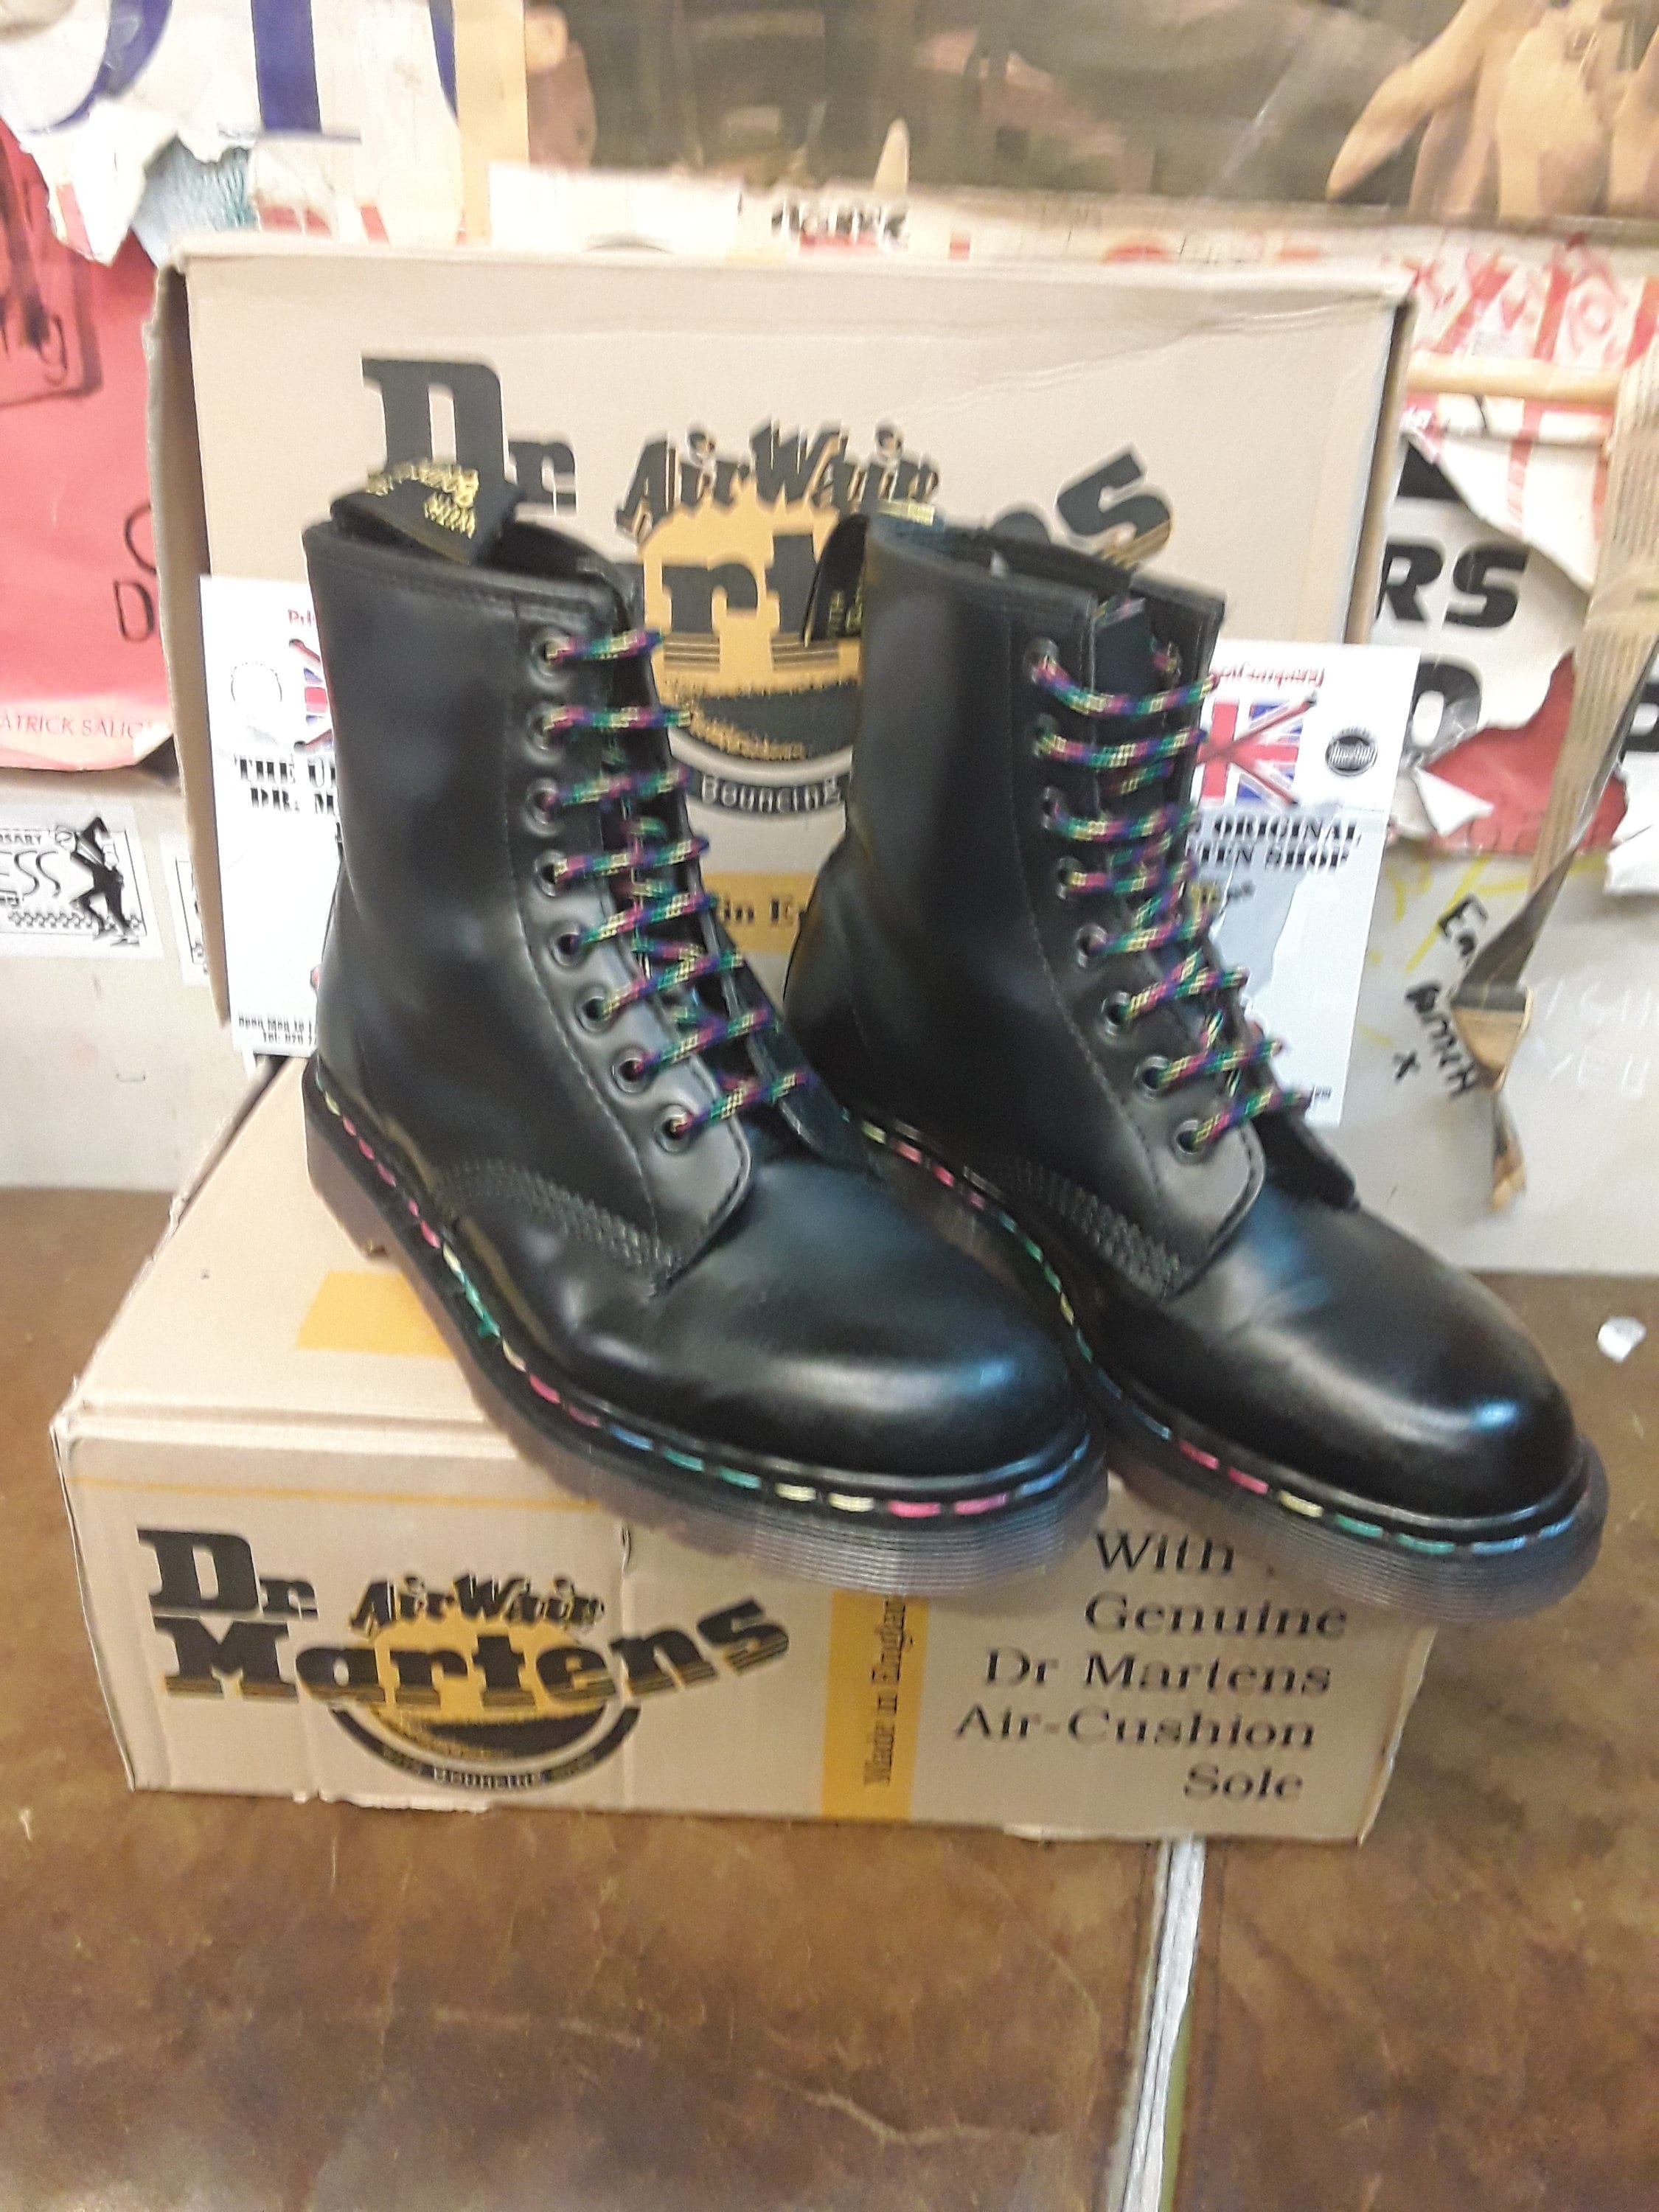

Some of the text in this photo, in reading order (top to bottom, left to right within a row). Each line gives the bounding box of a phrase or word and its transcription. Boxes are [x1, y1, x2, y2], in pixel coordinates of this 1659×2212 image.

[361, 358, 577, 514] Dr
[613, 422, 941, 542] AirWair
[136, 1529, 318, 1618] Dr
[1097, 1529, 1235, 1573] With
[349, 1572, 606, 1638] AirWair
[1085, 1590, 1348, 1639] Genuine
[152, 1599, 790, 1706] Martens
[986, 1648, 1332, 1694] Dr Martens
[956, 1703, 1315, 1748] Air-Cushion
[1184, 1763, 1304, 1801] Sole
